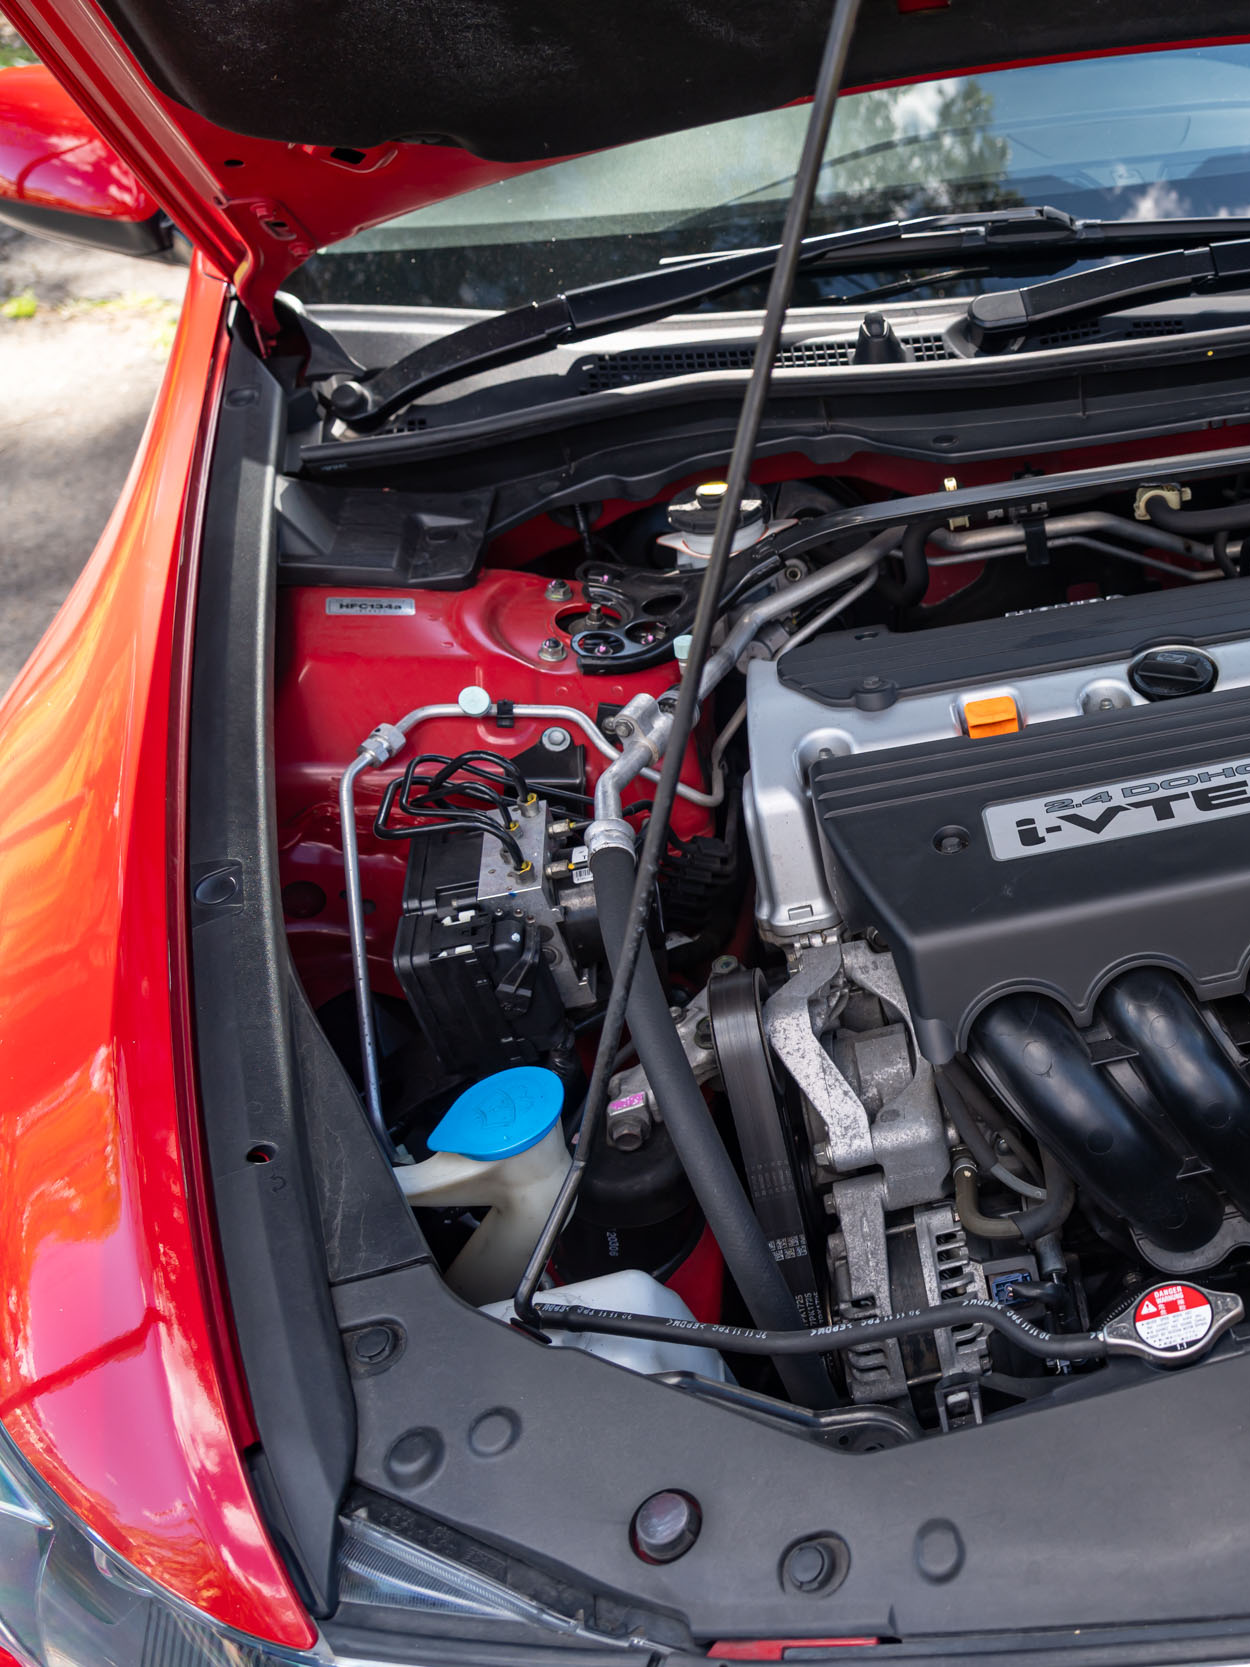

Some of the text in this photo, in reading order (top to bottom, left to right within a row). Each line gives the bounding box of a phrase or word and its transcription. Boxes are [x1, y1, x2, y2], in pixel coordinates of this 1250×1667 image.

[339, 602, 402, 610] HFC134a
[1044, 790, 1113, 814] 2.4
[1154, 1286, 1182, 1297] DANGER
